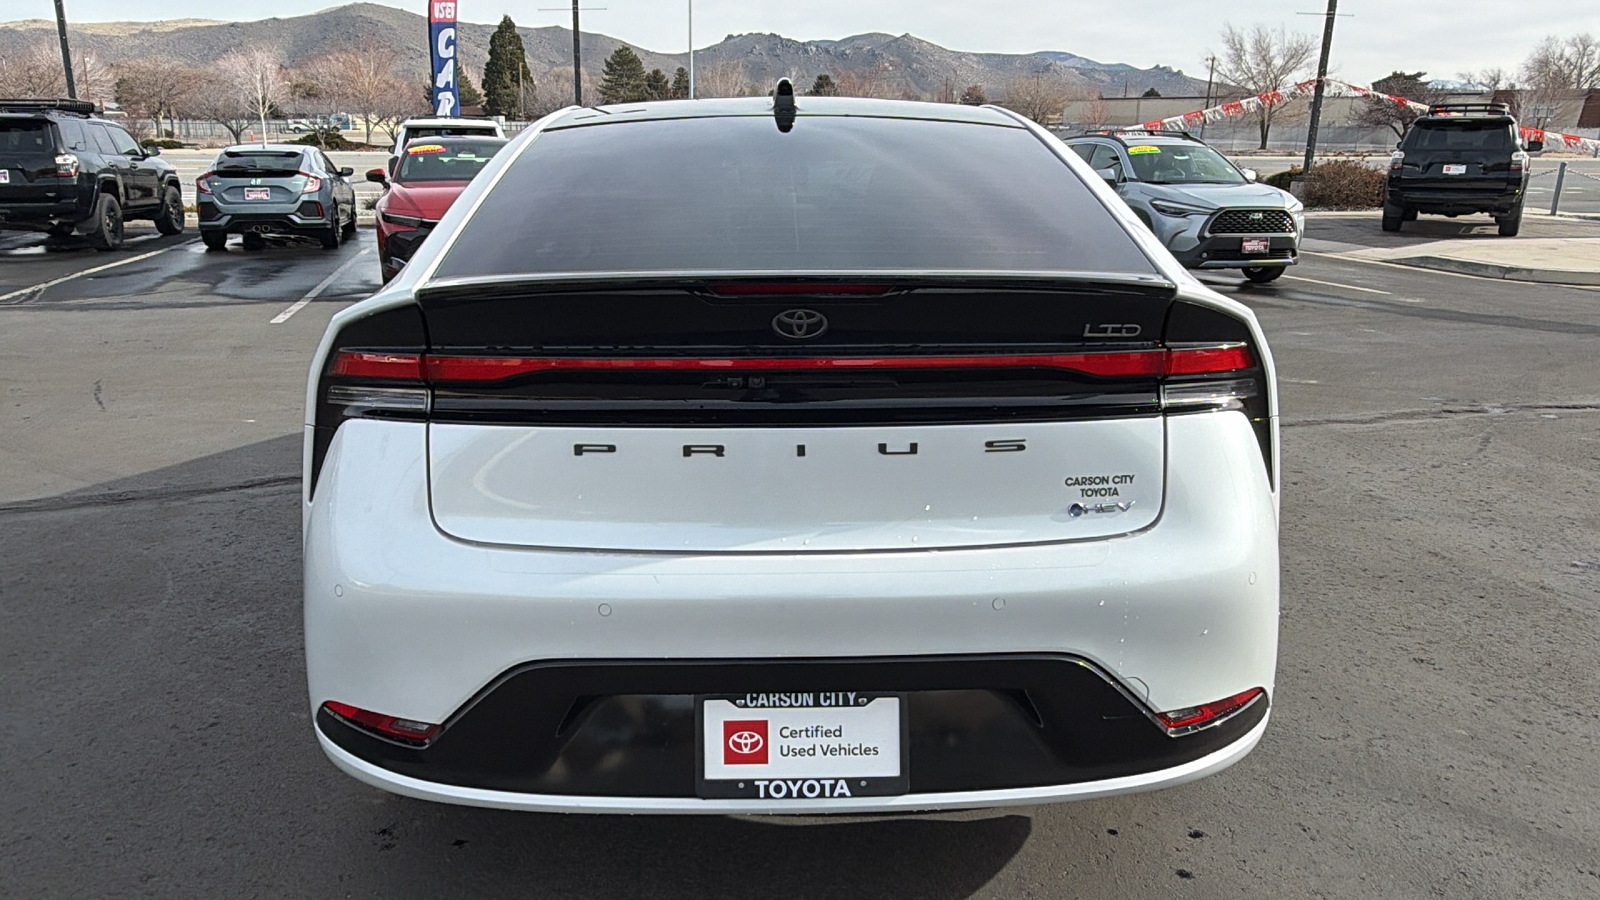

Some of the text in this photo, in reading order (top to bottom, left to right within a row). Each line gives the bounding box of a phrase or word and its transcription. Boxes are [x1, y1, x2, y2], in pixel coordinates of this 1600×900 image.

[1083, 324, 1141, 337] LTD
[574, 439, 1026, 457] PRIUS
[1065, 474, 1135, 486] CARSON CITY
[1080, 487, 1119, 497] TOYOTA
[746, 692, 857, 707] CARSON CITY
[779, 725, 843, 738] Certified
[779, 743, 879, 757] Used Vehicles
[754, 779, 851, 798] TOYOTA
